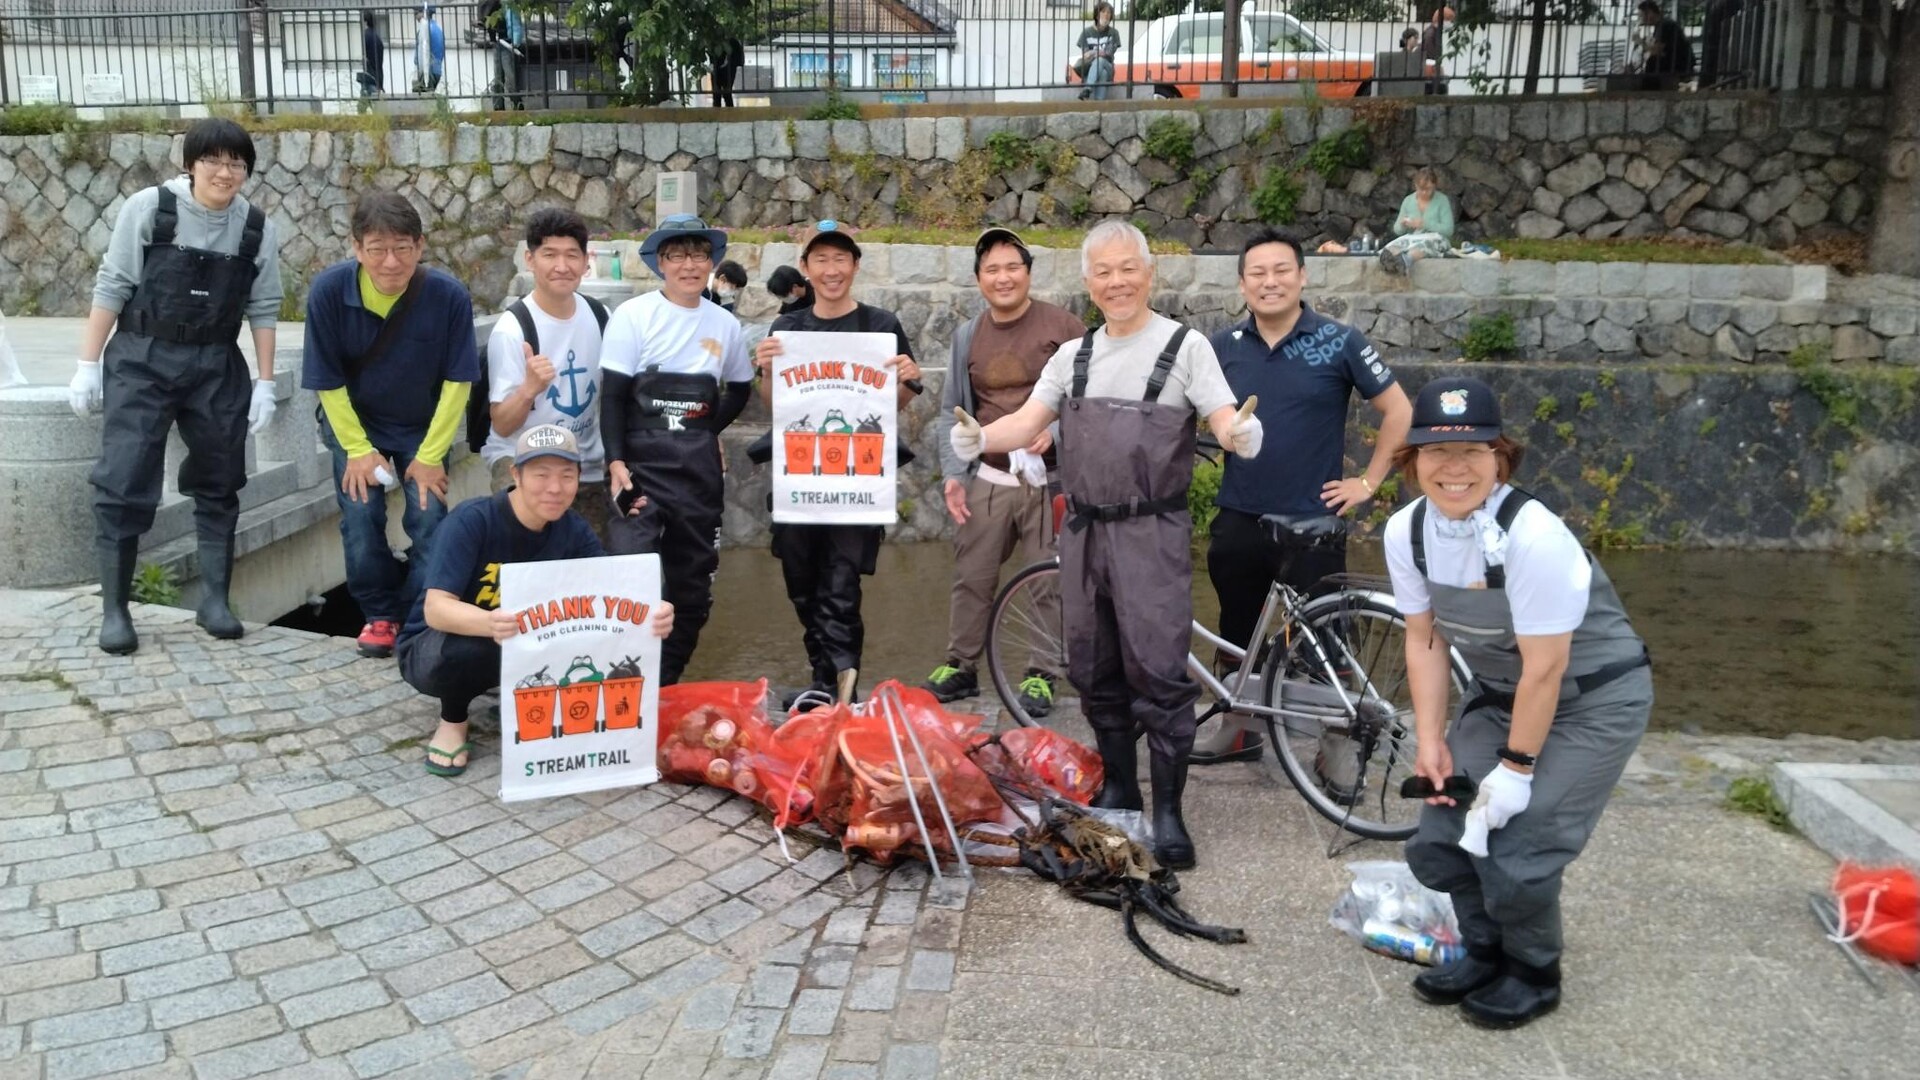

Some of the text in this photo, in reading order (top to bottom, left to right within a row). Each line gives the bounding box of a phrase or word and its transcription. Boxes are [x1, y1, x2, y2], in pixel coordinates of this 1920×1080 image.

[1282, 323, 1338, 360] Move
[780, 361, 888, 390] THANK YOU
[800, 383, 868, 395] FOR CLEANING UP
[515, 595, 650, 634] THANK YOU
[537, 624, 625, 643] FOR CLEANING UP
